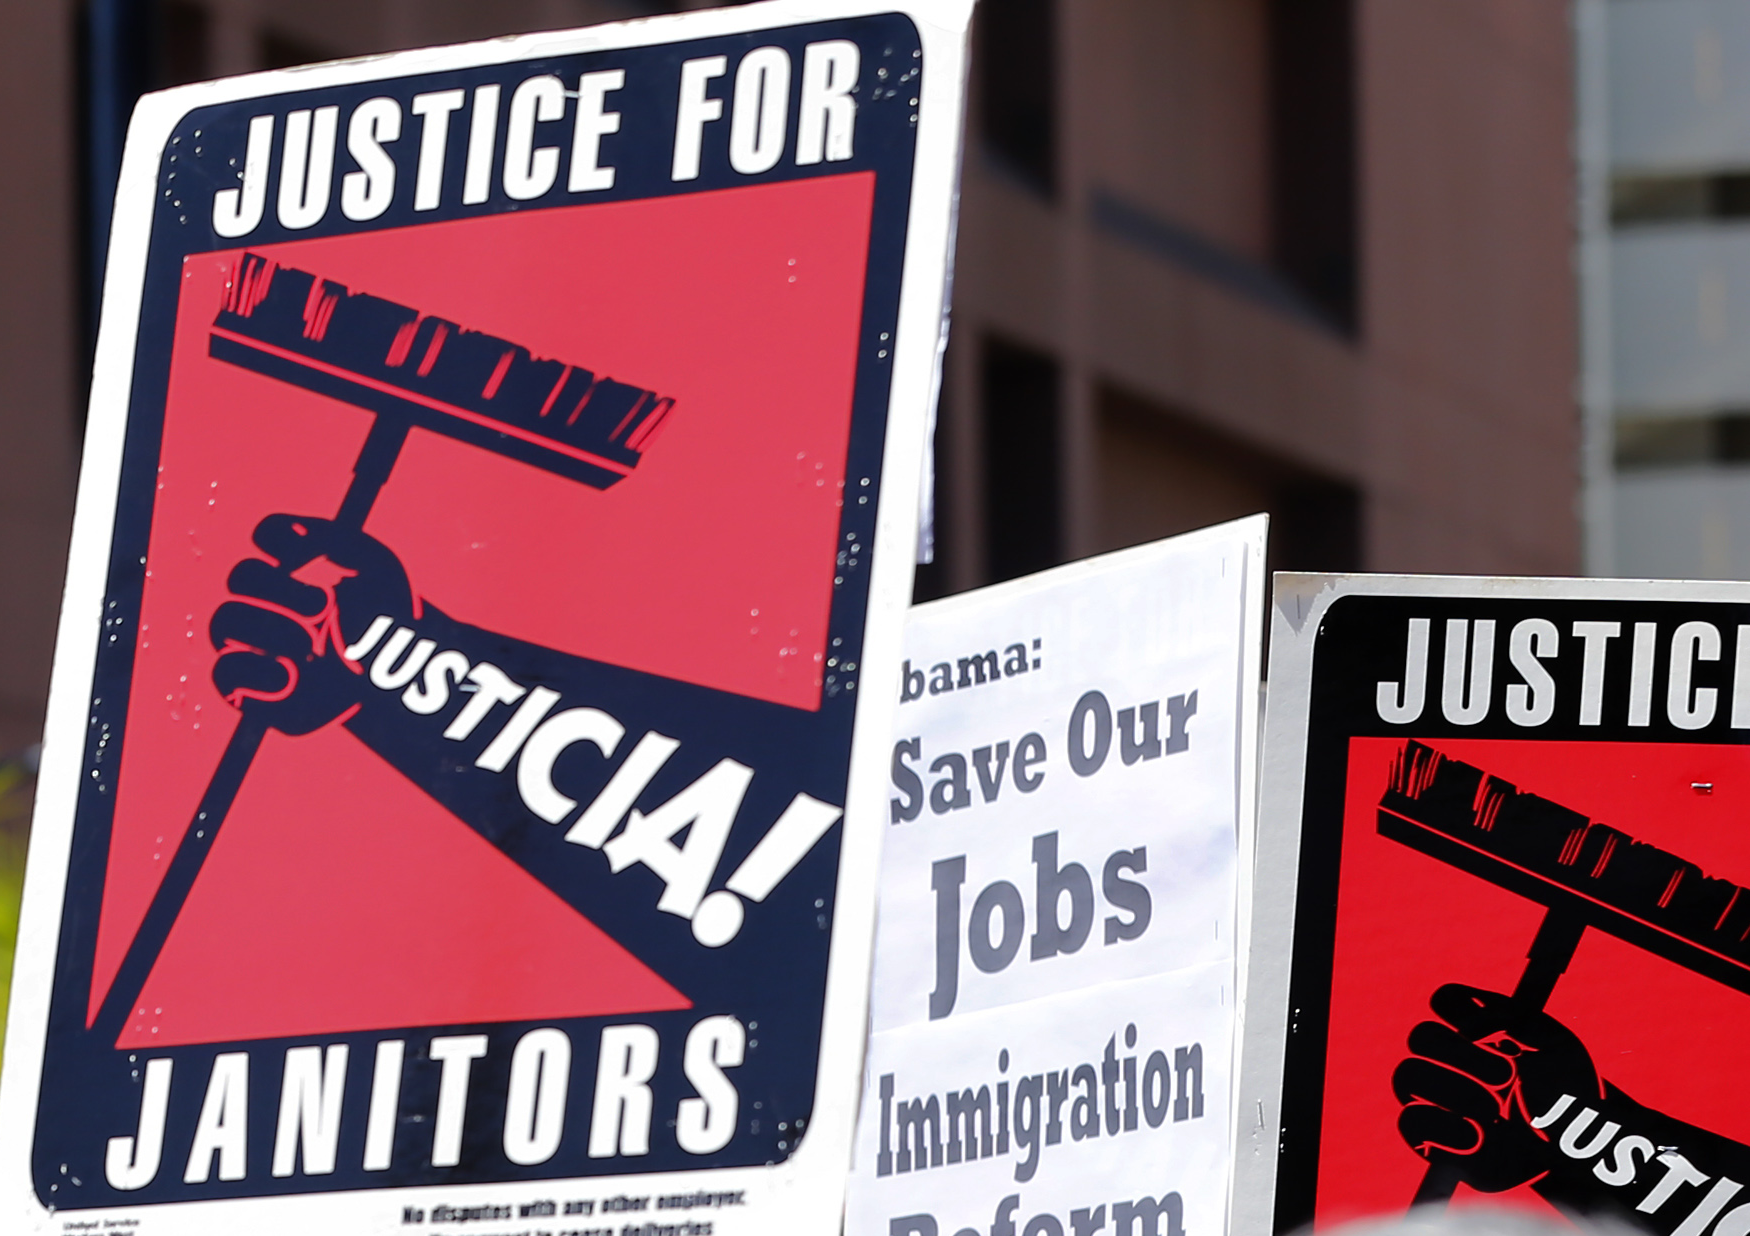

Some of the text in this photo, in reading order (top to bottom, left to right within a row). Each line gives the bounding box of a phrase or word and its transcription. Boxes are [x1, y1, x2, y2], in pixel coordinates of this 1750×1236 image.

[211, 40, 861, 239] JUSTICE FOR
[900, 638, 1042, 705] bama:
[344, 616, 843, 947] JUSTICIA!
[890, 689, 1199, 826] Save Our
[928, 830, 1152, 1021] Jobs
[104, 1016, 745, 1191] JANITORS
[876, 1022, 1205, 1184] Immigration
[402, 1207, 424, 1225] No
[431, 1203, 512, 1225] disputes
[518, 1200, 557, 1220] with
[562, 1200, 595, 1218] any
[601, 1194, 650, 1215] other
